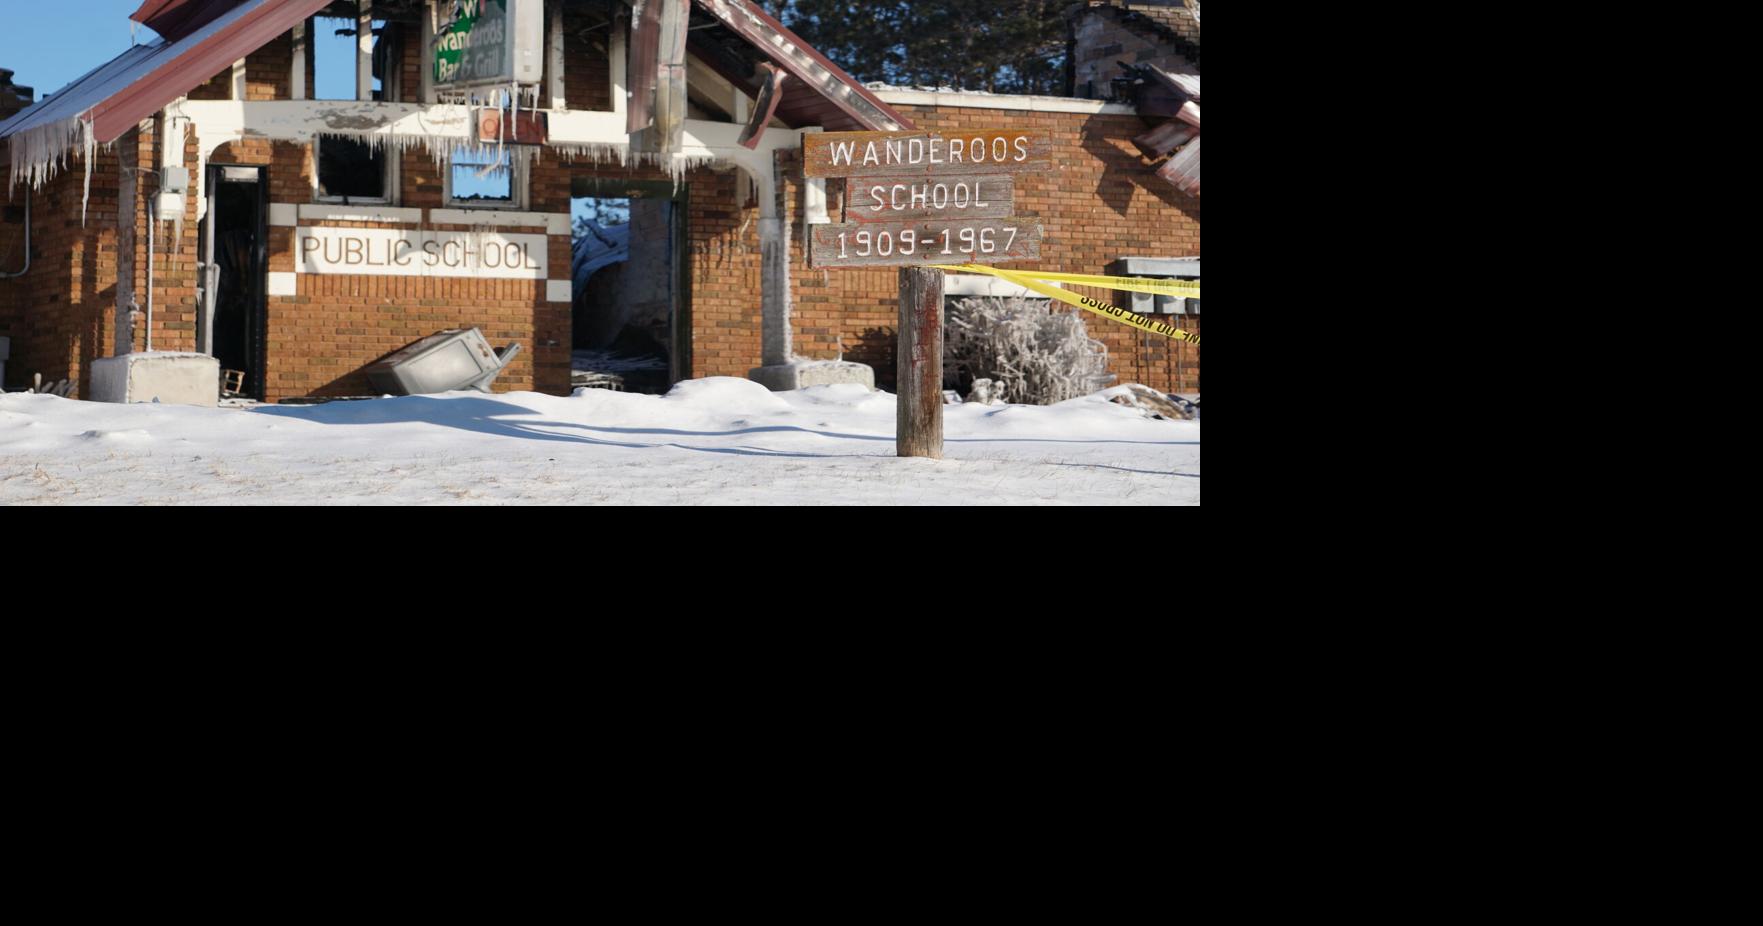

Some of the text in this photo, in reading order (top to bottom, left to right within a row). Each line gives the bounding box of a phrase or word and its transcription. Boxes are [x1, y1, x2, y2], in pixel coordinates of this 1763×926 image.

[438, 47, 500, 82] Bar & Grill
[829, 136, 1028, 166] WANDEROOS
[869, 182, 989, 211] SCHOOL
[302, 236, 542, 270] PUBLIC SCHOOL
[837, 227, 1018, 259] 1909-1967
